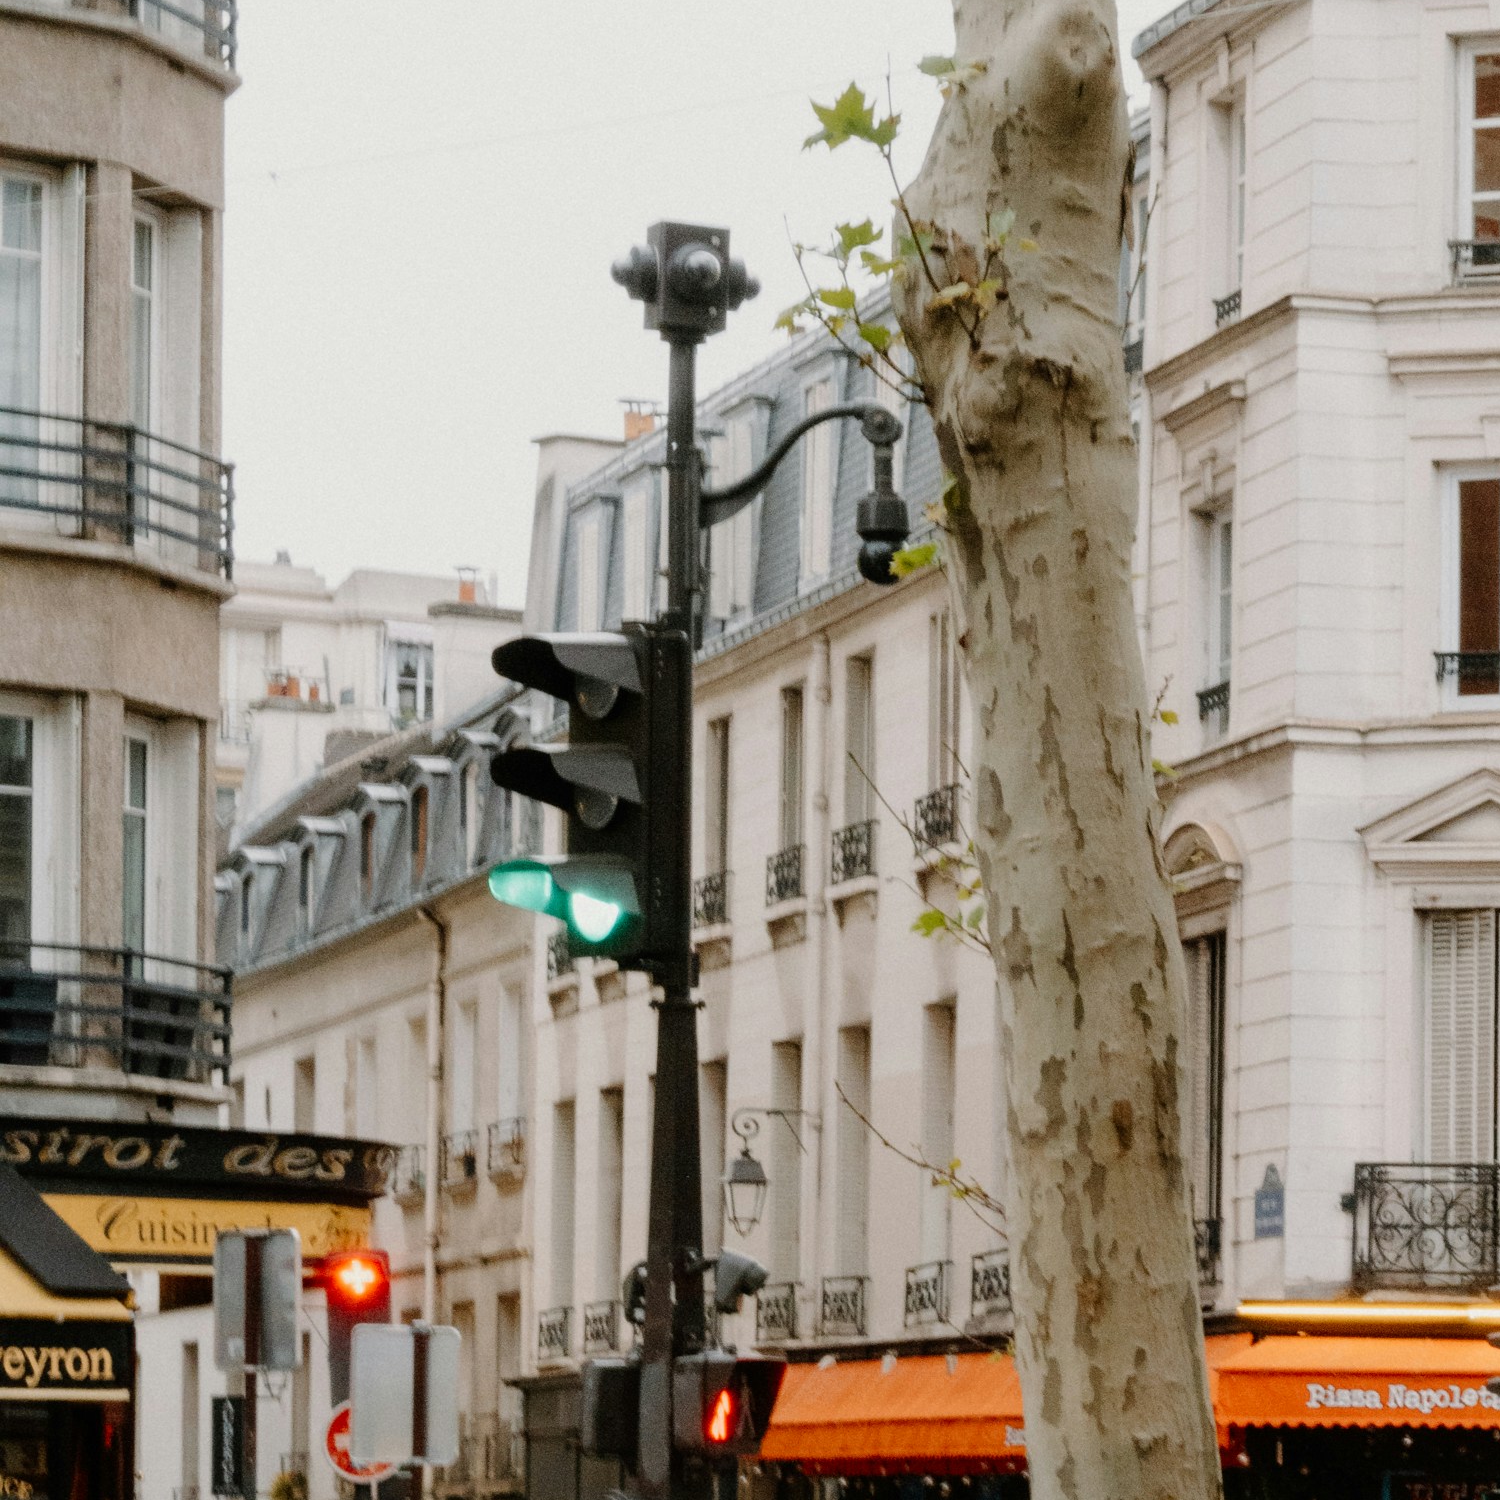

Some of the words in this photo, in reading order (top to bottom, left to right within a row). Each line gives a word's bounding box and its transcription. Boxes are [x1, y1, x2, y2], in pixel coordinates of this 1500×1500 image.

[1, 1126, 187, 1171] strot
[223, 1133, 355, 1181] des
[0, 1345, 116, 1388] eyron
[1305, 1382, 1384, 1410] Pizza
